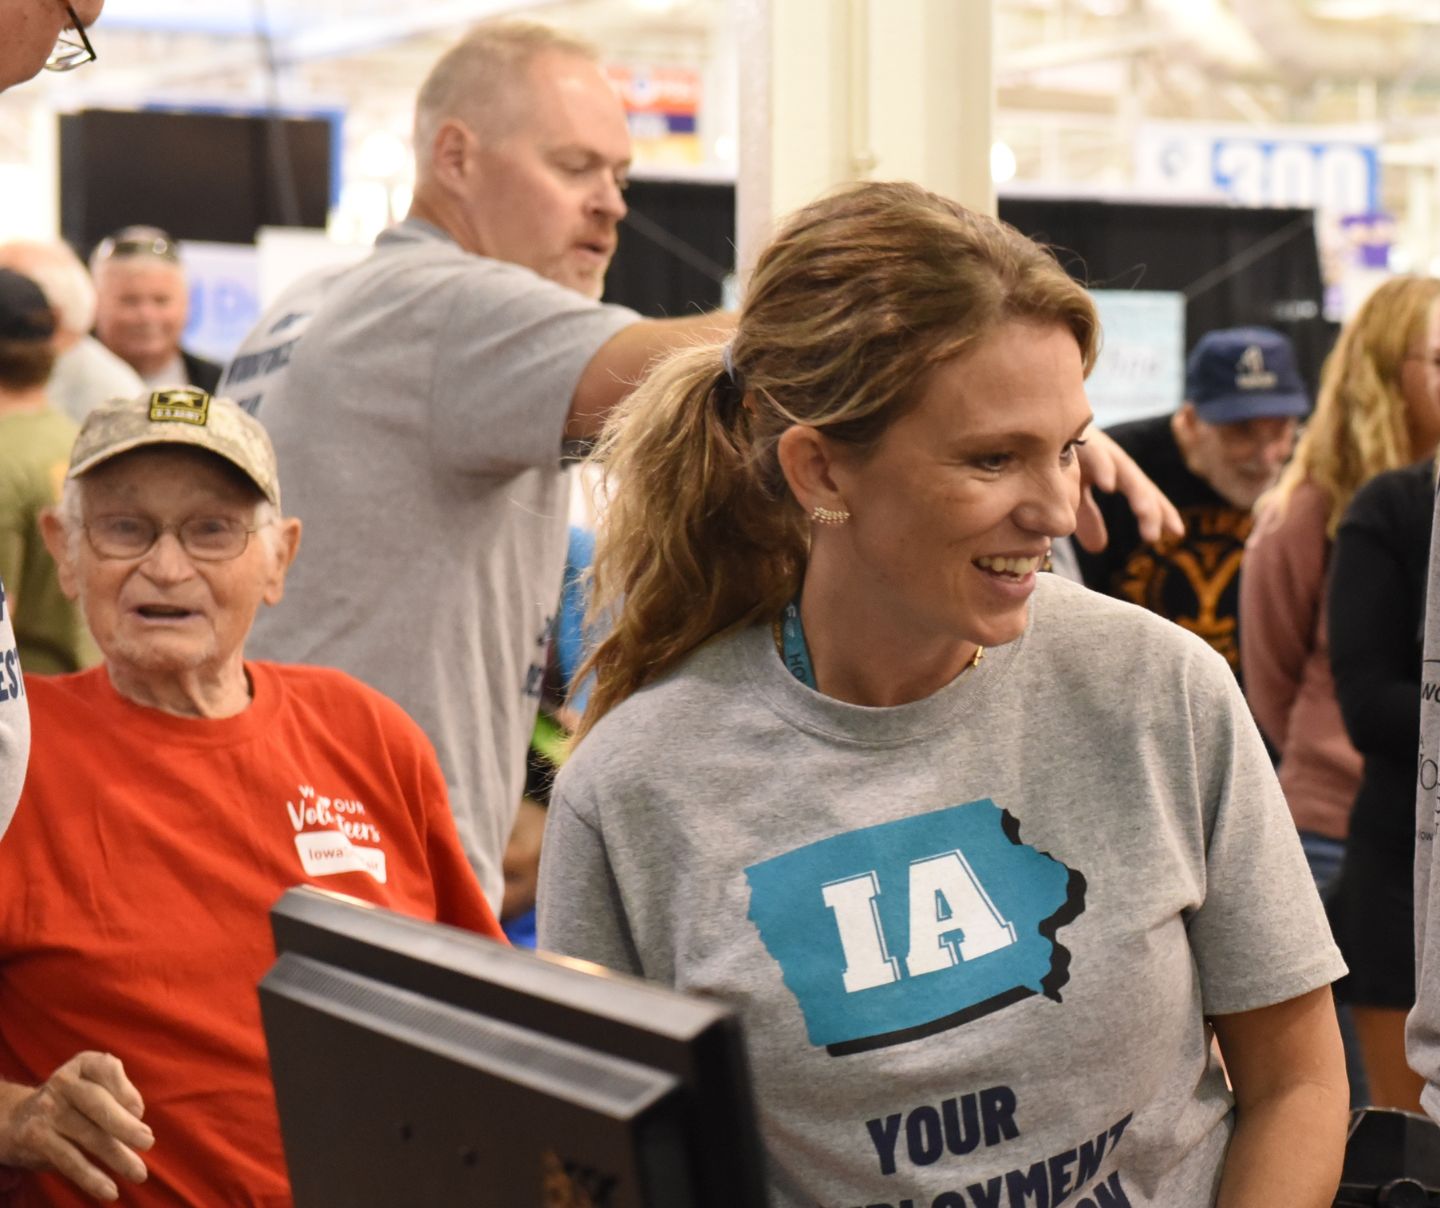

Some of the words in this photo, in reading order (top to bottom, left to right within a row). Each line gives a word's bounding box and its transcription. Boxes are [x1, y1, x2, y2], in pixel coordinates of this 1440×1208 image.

[333, 797, 366, 816] OUR
[309, 848, 344, 861] Iowa
[821, 848, 1018, 994] IA
[866, 1085, 1020, 1176] YOUR
